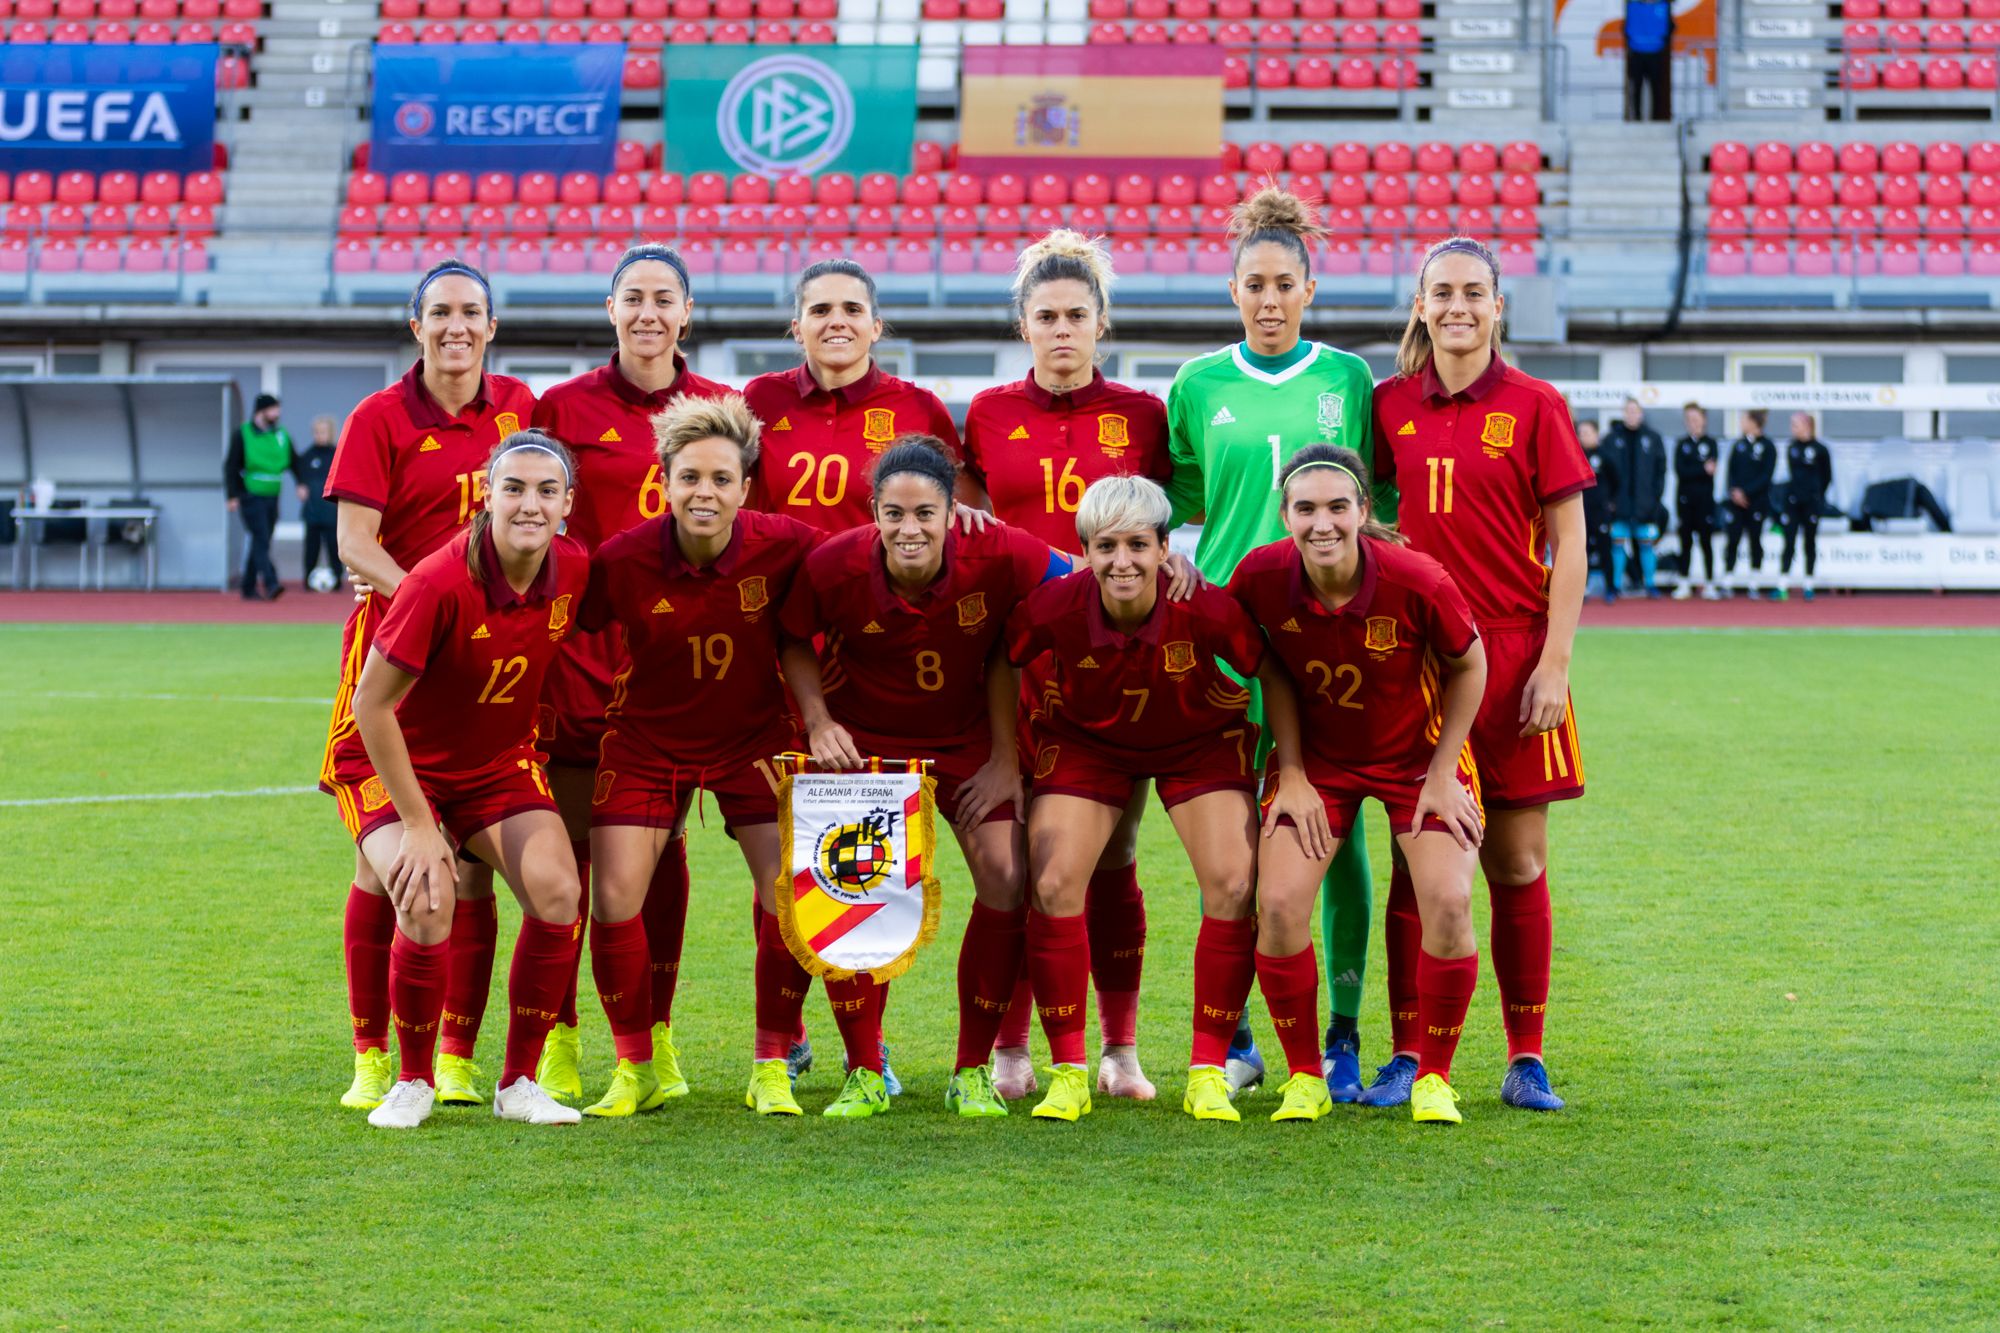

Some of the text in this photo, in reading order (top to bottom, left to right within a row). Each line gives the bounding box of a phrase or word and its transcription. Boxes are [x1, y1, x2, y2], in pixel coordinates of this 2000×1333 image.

[0, 90, 181, 141] UEFA
[445, 103, 603, 136] RESPECT
[638, 464, 667, 520] 6
[787, 452, 849, 507] 20
[1039, 457, 1086, 514] 16
[1426, 457, 1455, 513] 11
[1879, 549, 1922, 563] Seite
[477, 655, 529, 704] 12
[687, 633, 734, 681] 19
[915, 650, 945, 692] 8
[1122, 688, 1150, 723] 7
[1305, 660, 1364, 710] 22
[1223, 729, 1246, 776] 7
[1539, 729, 1568, 781] 11
[807, 787, 852, 797] ALEMANIA
[861, 786, 894, 797] ESPAÑA
[1113, 946, 1145, 959] RFE
